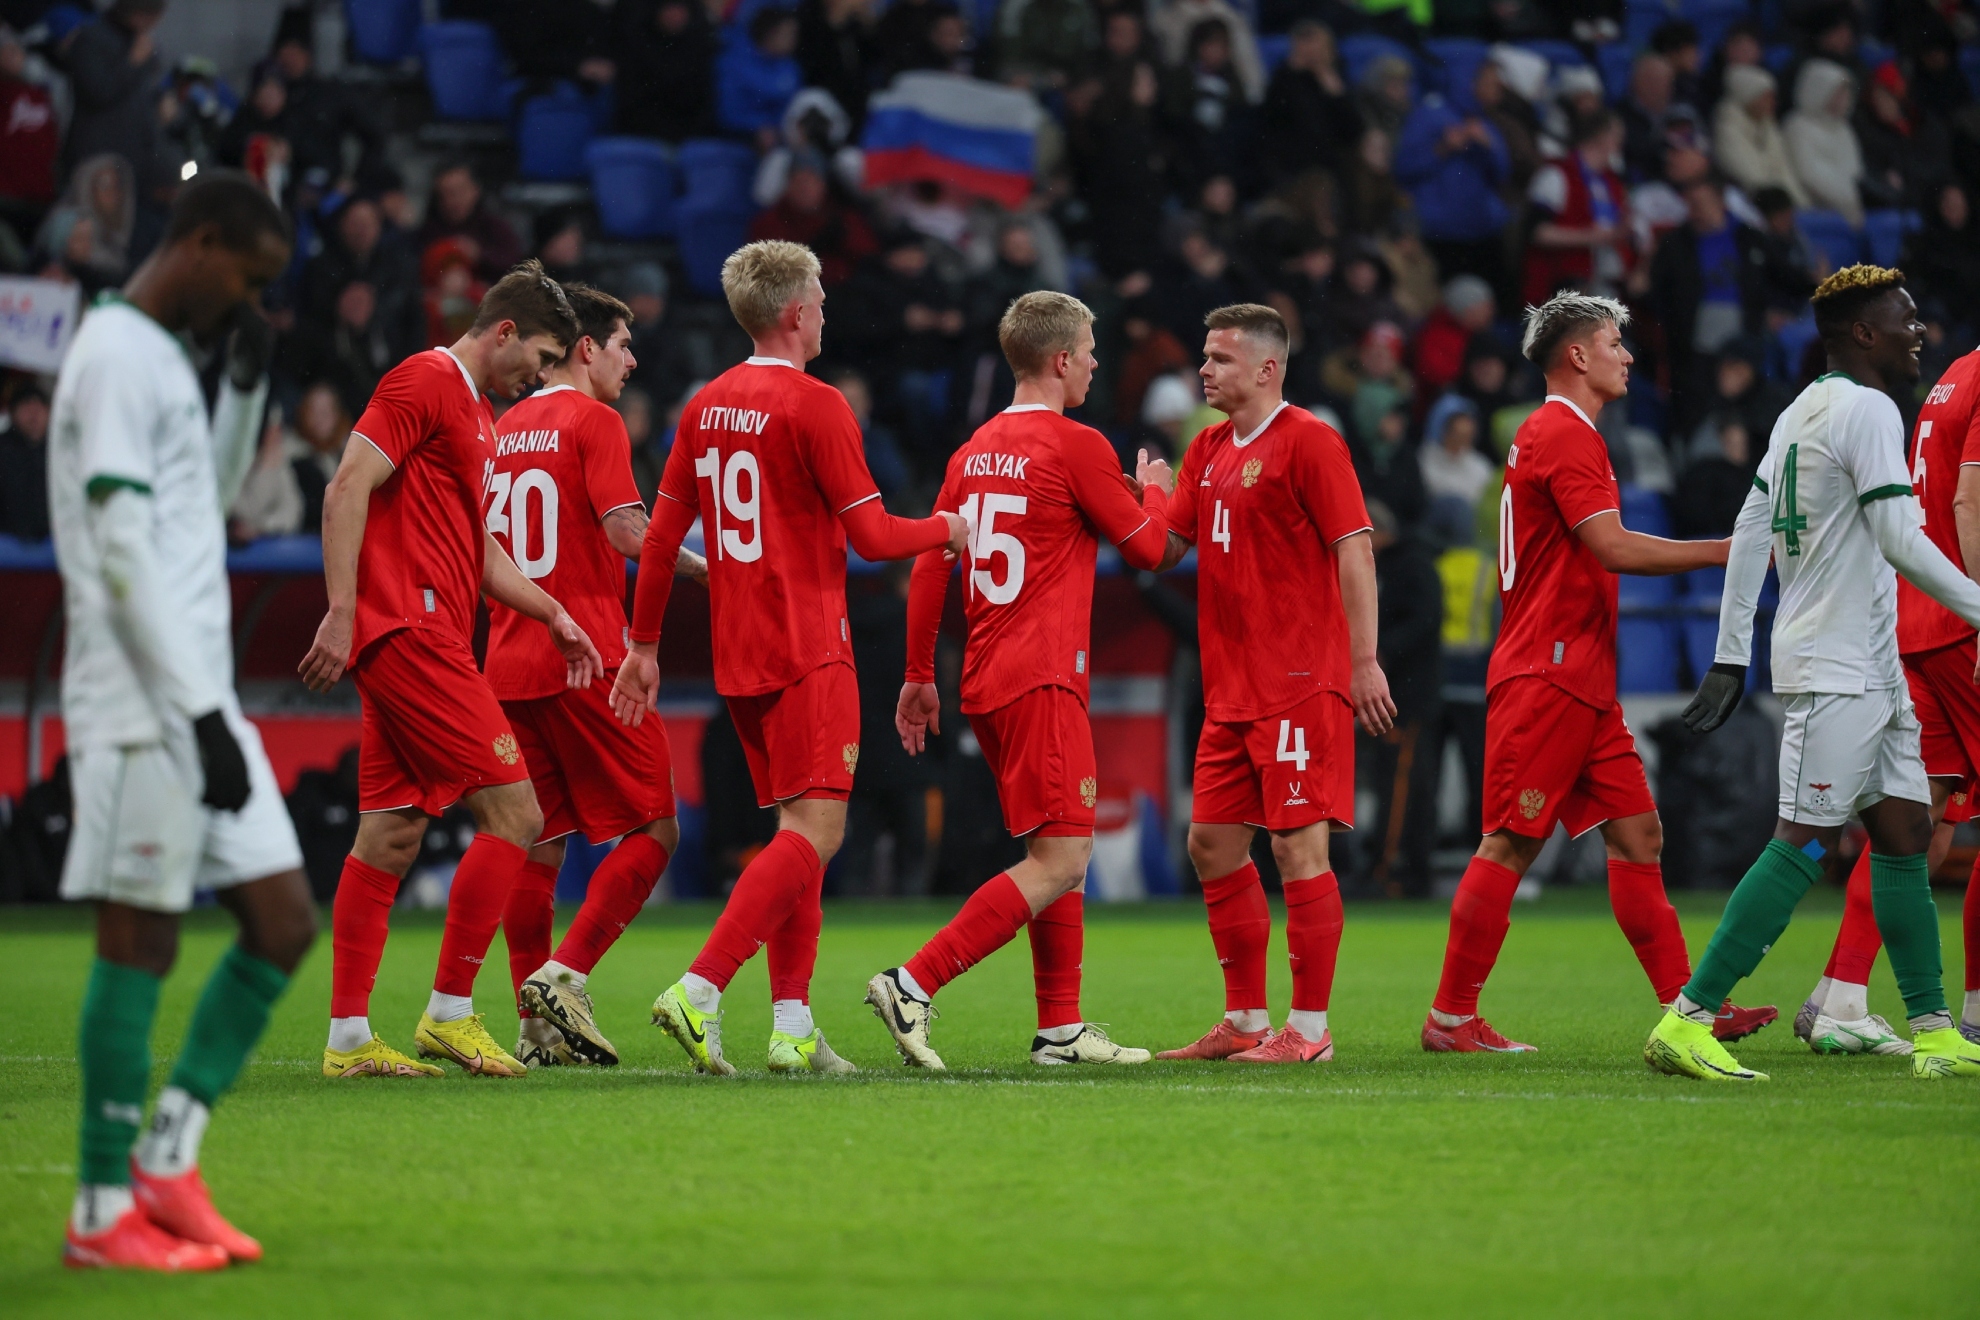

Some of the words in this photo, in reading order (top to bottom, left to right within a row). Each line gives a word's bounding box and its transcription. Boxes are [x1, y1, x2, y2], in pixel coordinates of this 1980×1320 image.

[699, 407, 770, 435] LITVINOV
[695, 446, 763, 563] 19
[963, 452, 1030, 480] KISLYAK
[1771, 442, 1808, 557] 4
[485, 467, 559, 579] 30
[958, 492, 1028, 605] 15
[1211, 499, 1231, 553] 4
[1276, 719, 1310, 772] 4
